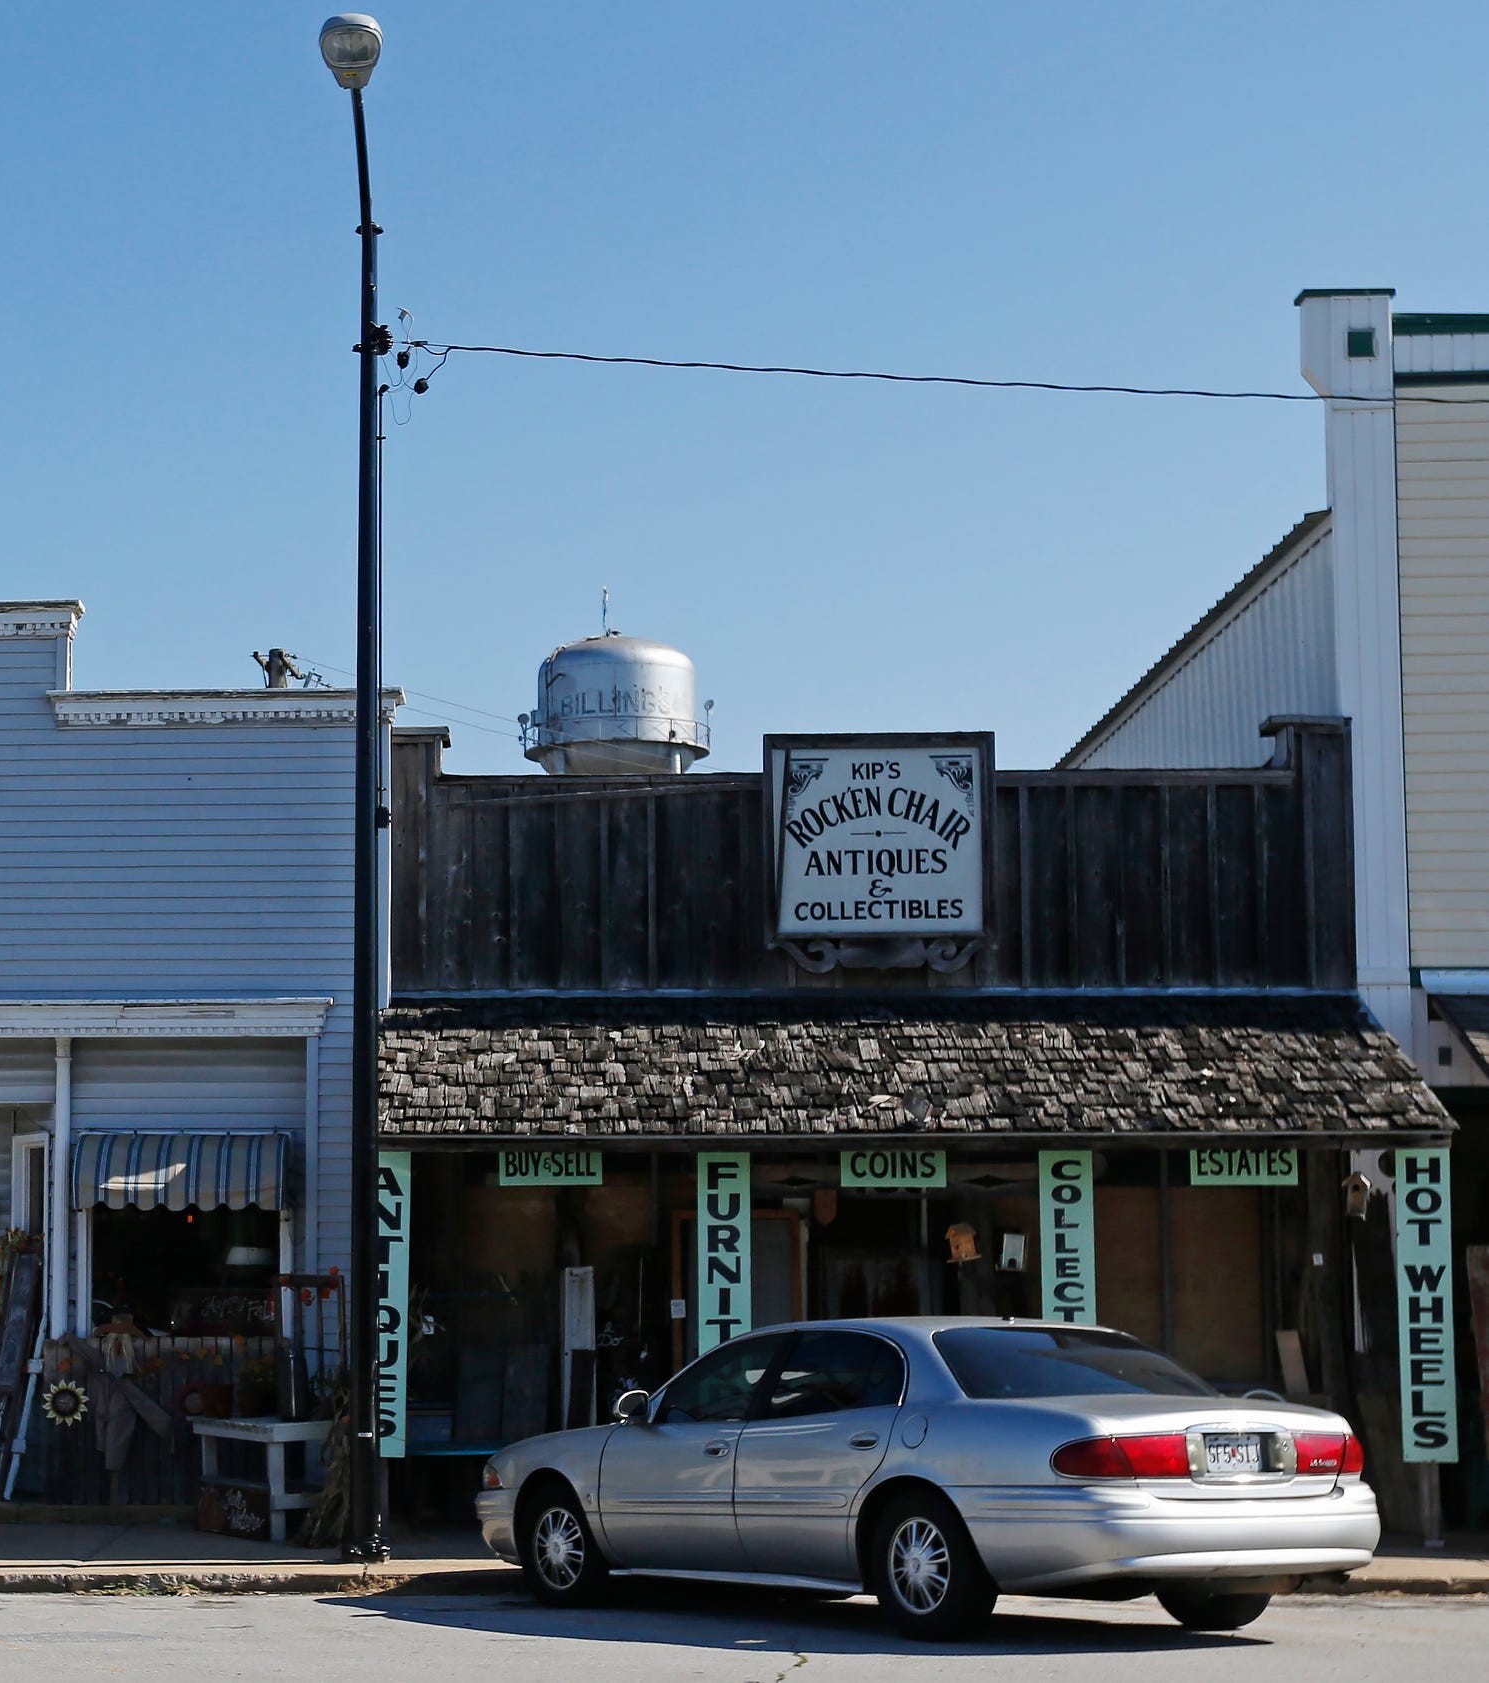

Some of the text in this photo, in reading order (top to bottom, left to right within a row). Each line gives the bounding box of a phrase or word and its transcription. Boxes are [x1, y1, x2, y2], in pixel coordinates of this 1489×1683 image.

[561, 688, 671, 717] BILLINGS
[851, 760, 901, 780] KIP'S
[887, 787, 971, 850] CHAIR
[804, 848, 948, 878] ANTIQUES
[868, 879, 892, 898] &
[794, 899, 963, 921] COLLECTIBLES
[850, 1152, 937, 1179] COINS
[1196, 1150, 1293, 1176] ESTATES
[1051, 1160, 1085, 1322] COLLECT
[1403, 1157, 1449, 1449] HOT WHEELS
